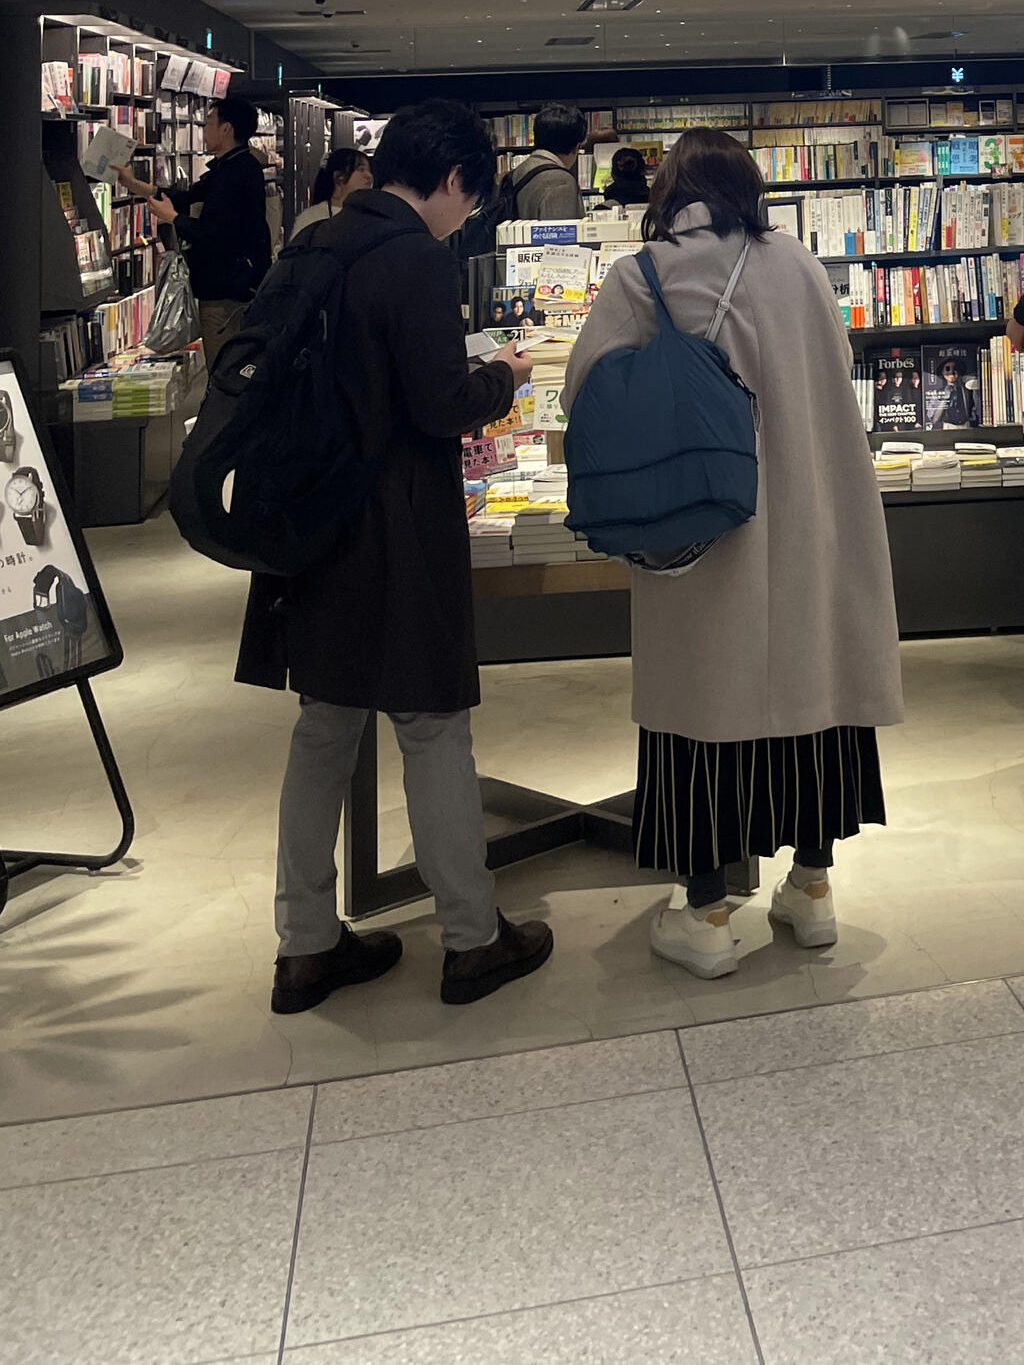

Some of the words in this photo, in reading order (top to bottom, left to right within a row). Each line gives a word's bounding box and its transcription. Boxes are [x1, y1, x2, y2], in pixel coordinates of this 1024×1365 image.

[492, 288, 530, 301] DIME
[878, 357, 915, 370] Forbes
[878, 403, 917, 413] IMPACT
[4, 634, 15, 643] For
[15, 627, 33, 640] Apple
[33, 620, 53, 633] Watch
